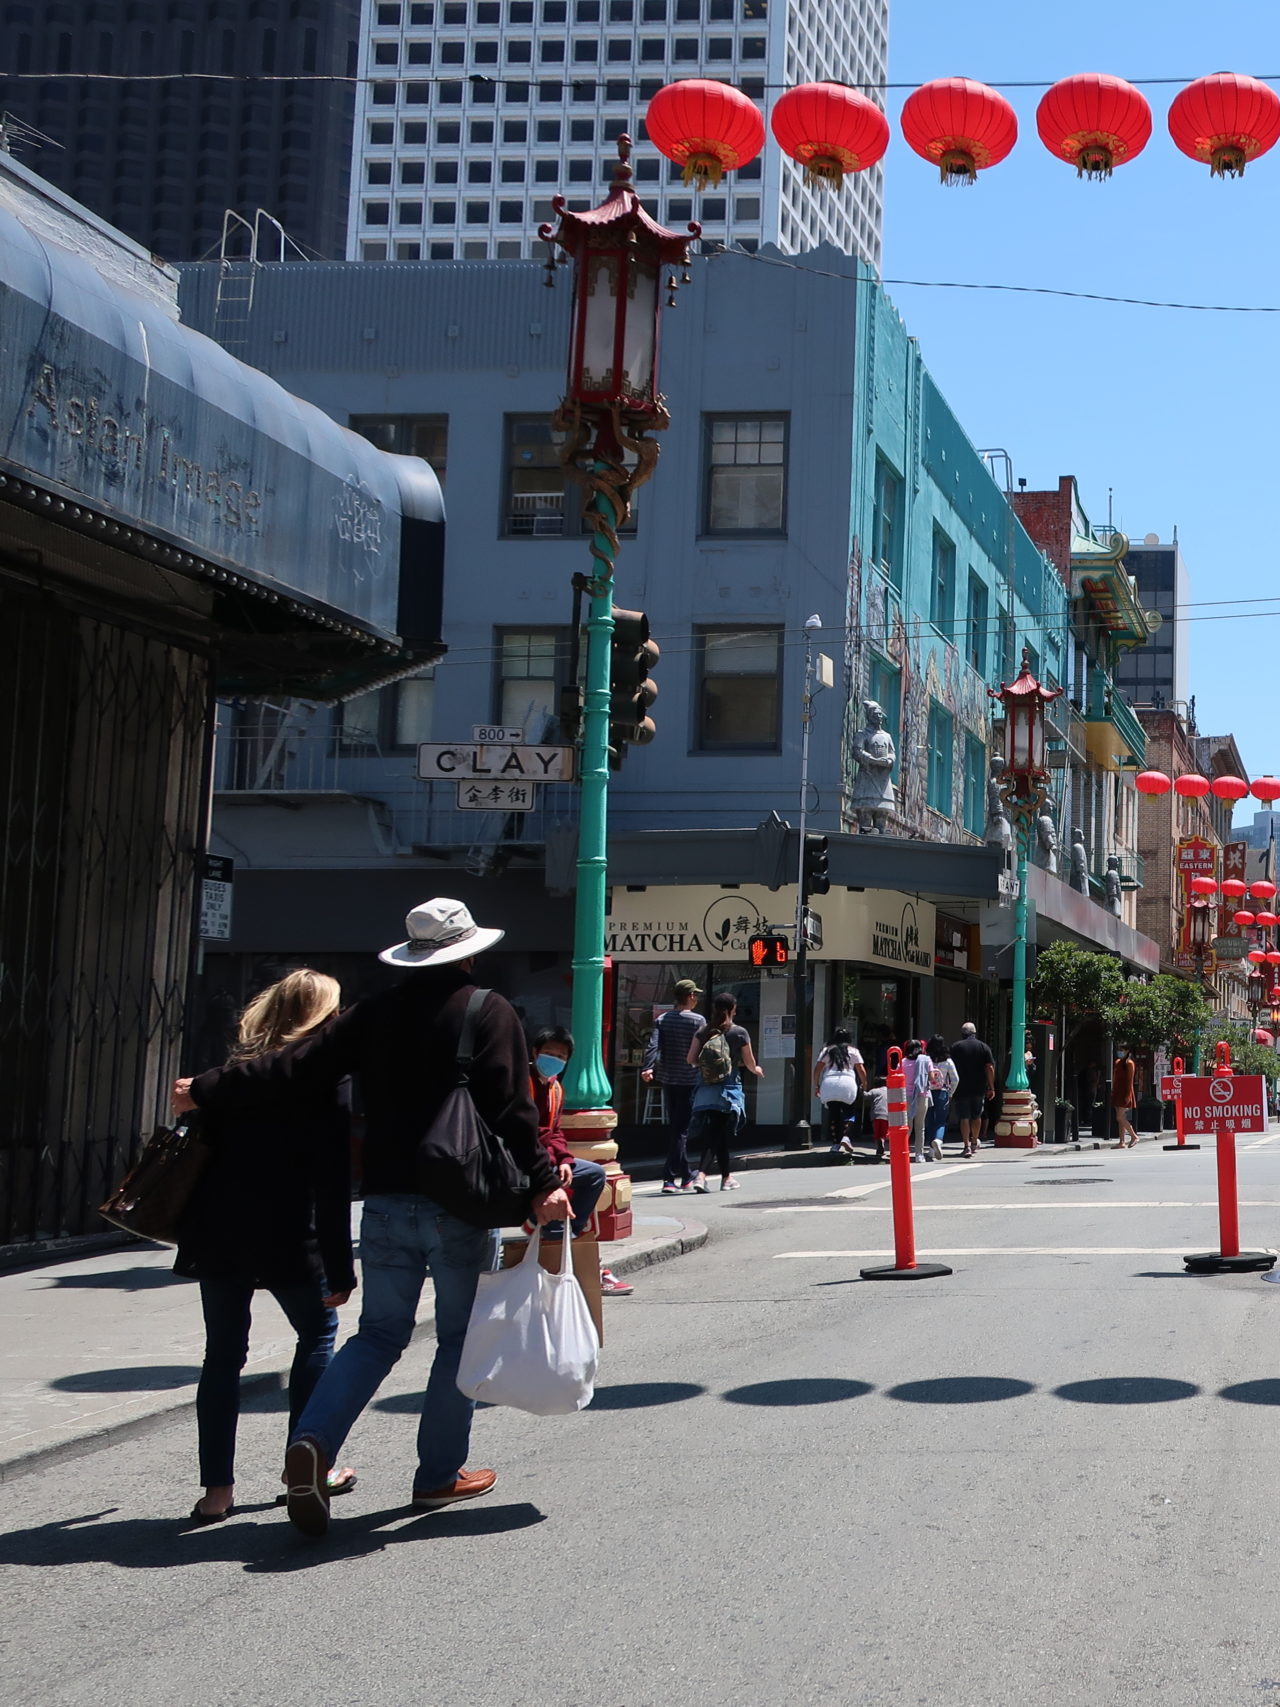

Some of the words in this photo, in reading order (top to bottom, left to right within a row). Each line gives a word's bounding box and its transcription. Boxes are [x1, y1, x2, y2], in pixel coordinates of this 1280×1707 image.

[25, 363, 144, 471] Asian
[159, 425, 264, 527] Image
[478, 728, 505, 740] 800
[436, 751, 559, 775] CLAY
[464, 784, 528, 804] 企李街
[609, 922, 689, 932] PREMIUM
[875, 921, 898, 937] PREMIUM
[604, 934, 704, 952] MATCHA
[872, 934, 902, 961] MATCHA
[1184, 1107, 1200, 1119] NO
[1205, 1104, 1261, 1118] SMOKING
